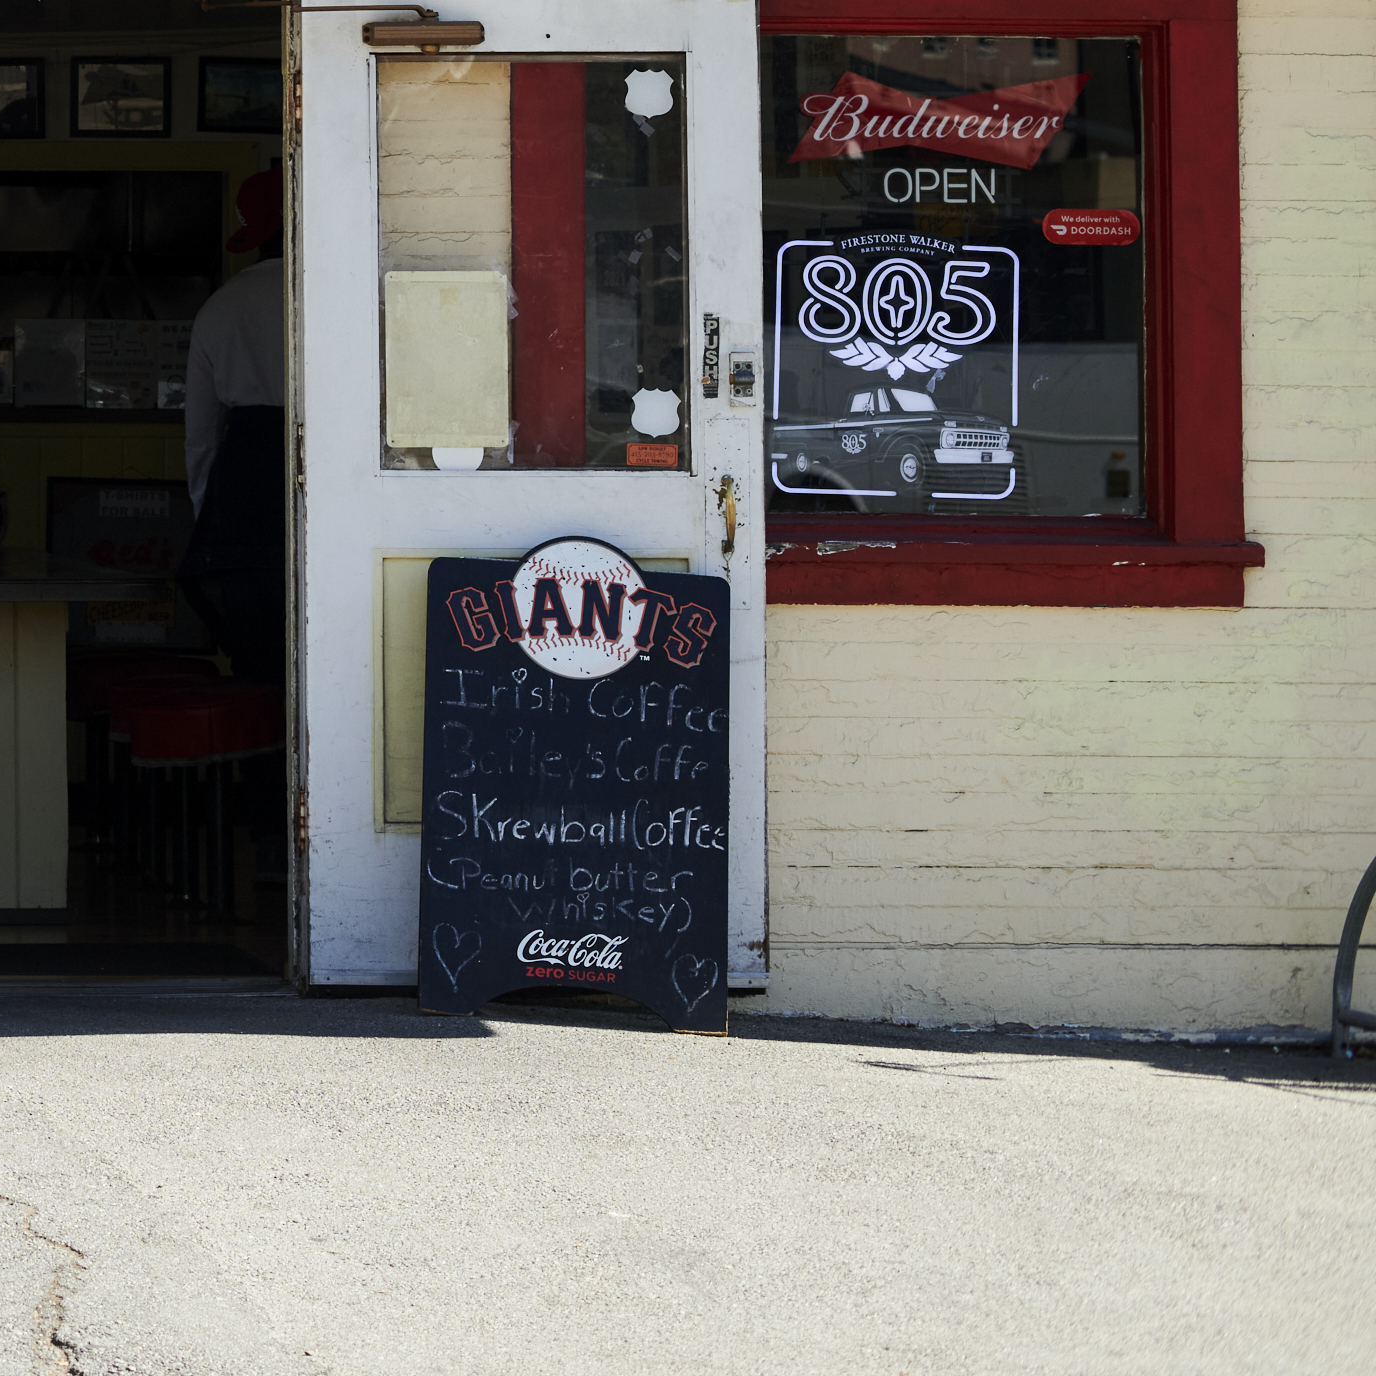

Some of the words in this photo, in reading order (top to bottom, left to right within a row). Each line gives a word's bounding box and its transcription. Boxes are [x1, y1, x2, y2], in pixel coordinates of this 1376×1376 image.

[803, 94, 1061, 142] Budweiser
[883, 167, 996, 204] OPEN
[1061, 215, 1074, 223] We
[1075, 215, 1102, 223] deliver
[1103, 215, 1121, 223] with
[1071, 226, 1132, 235] DOORDASH
[841, 234, 906, 250] FIRESTONE
[909, 234, 956, 254] WALKER
[861, 246, 896, 254] BREWING
[898, 246, 935, 256] COMPANY
[798, 255, 997, 345] 805
[446, 576, 717, 669] GIANTS
[440, 667, 570, 714] Irish
[516, 929, 629, 970] Coca-Cola
[526, 966, 565, 979] zero
[568, 969, 616, 983] SUGAR
